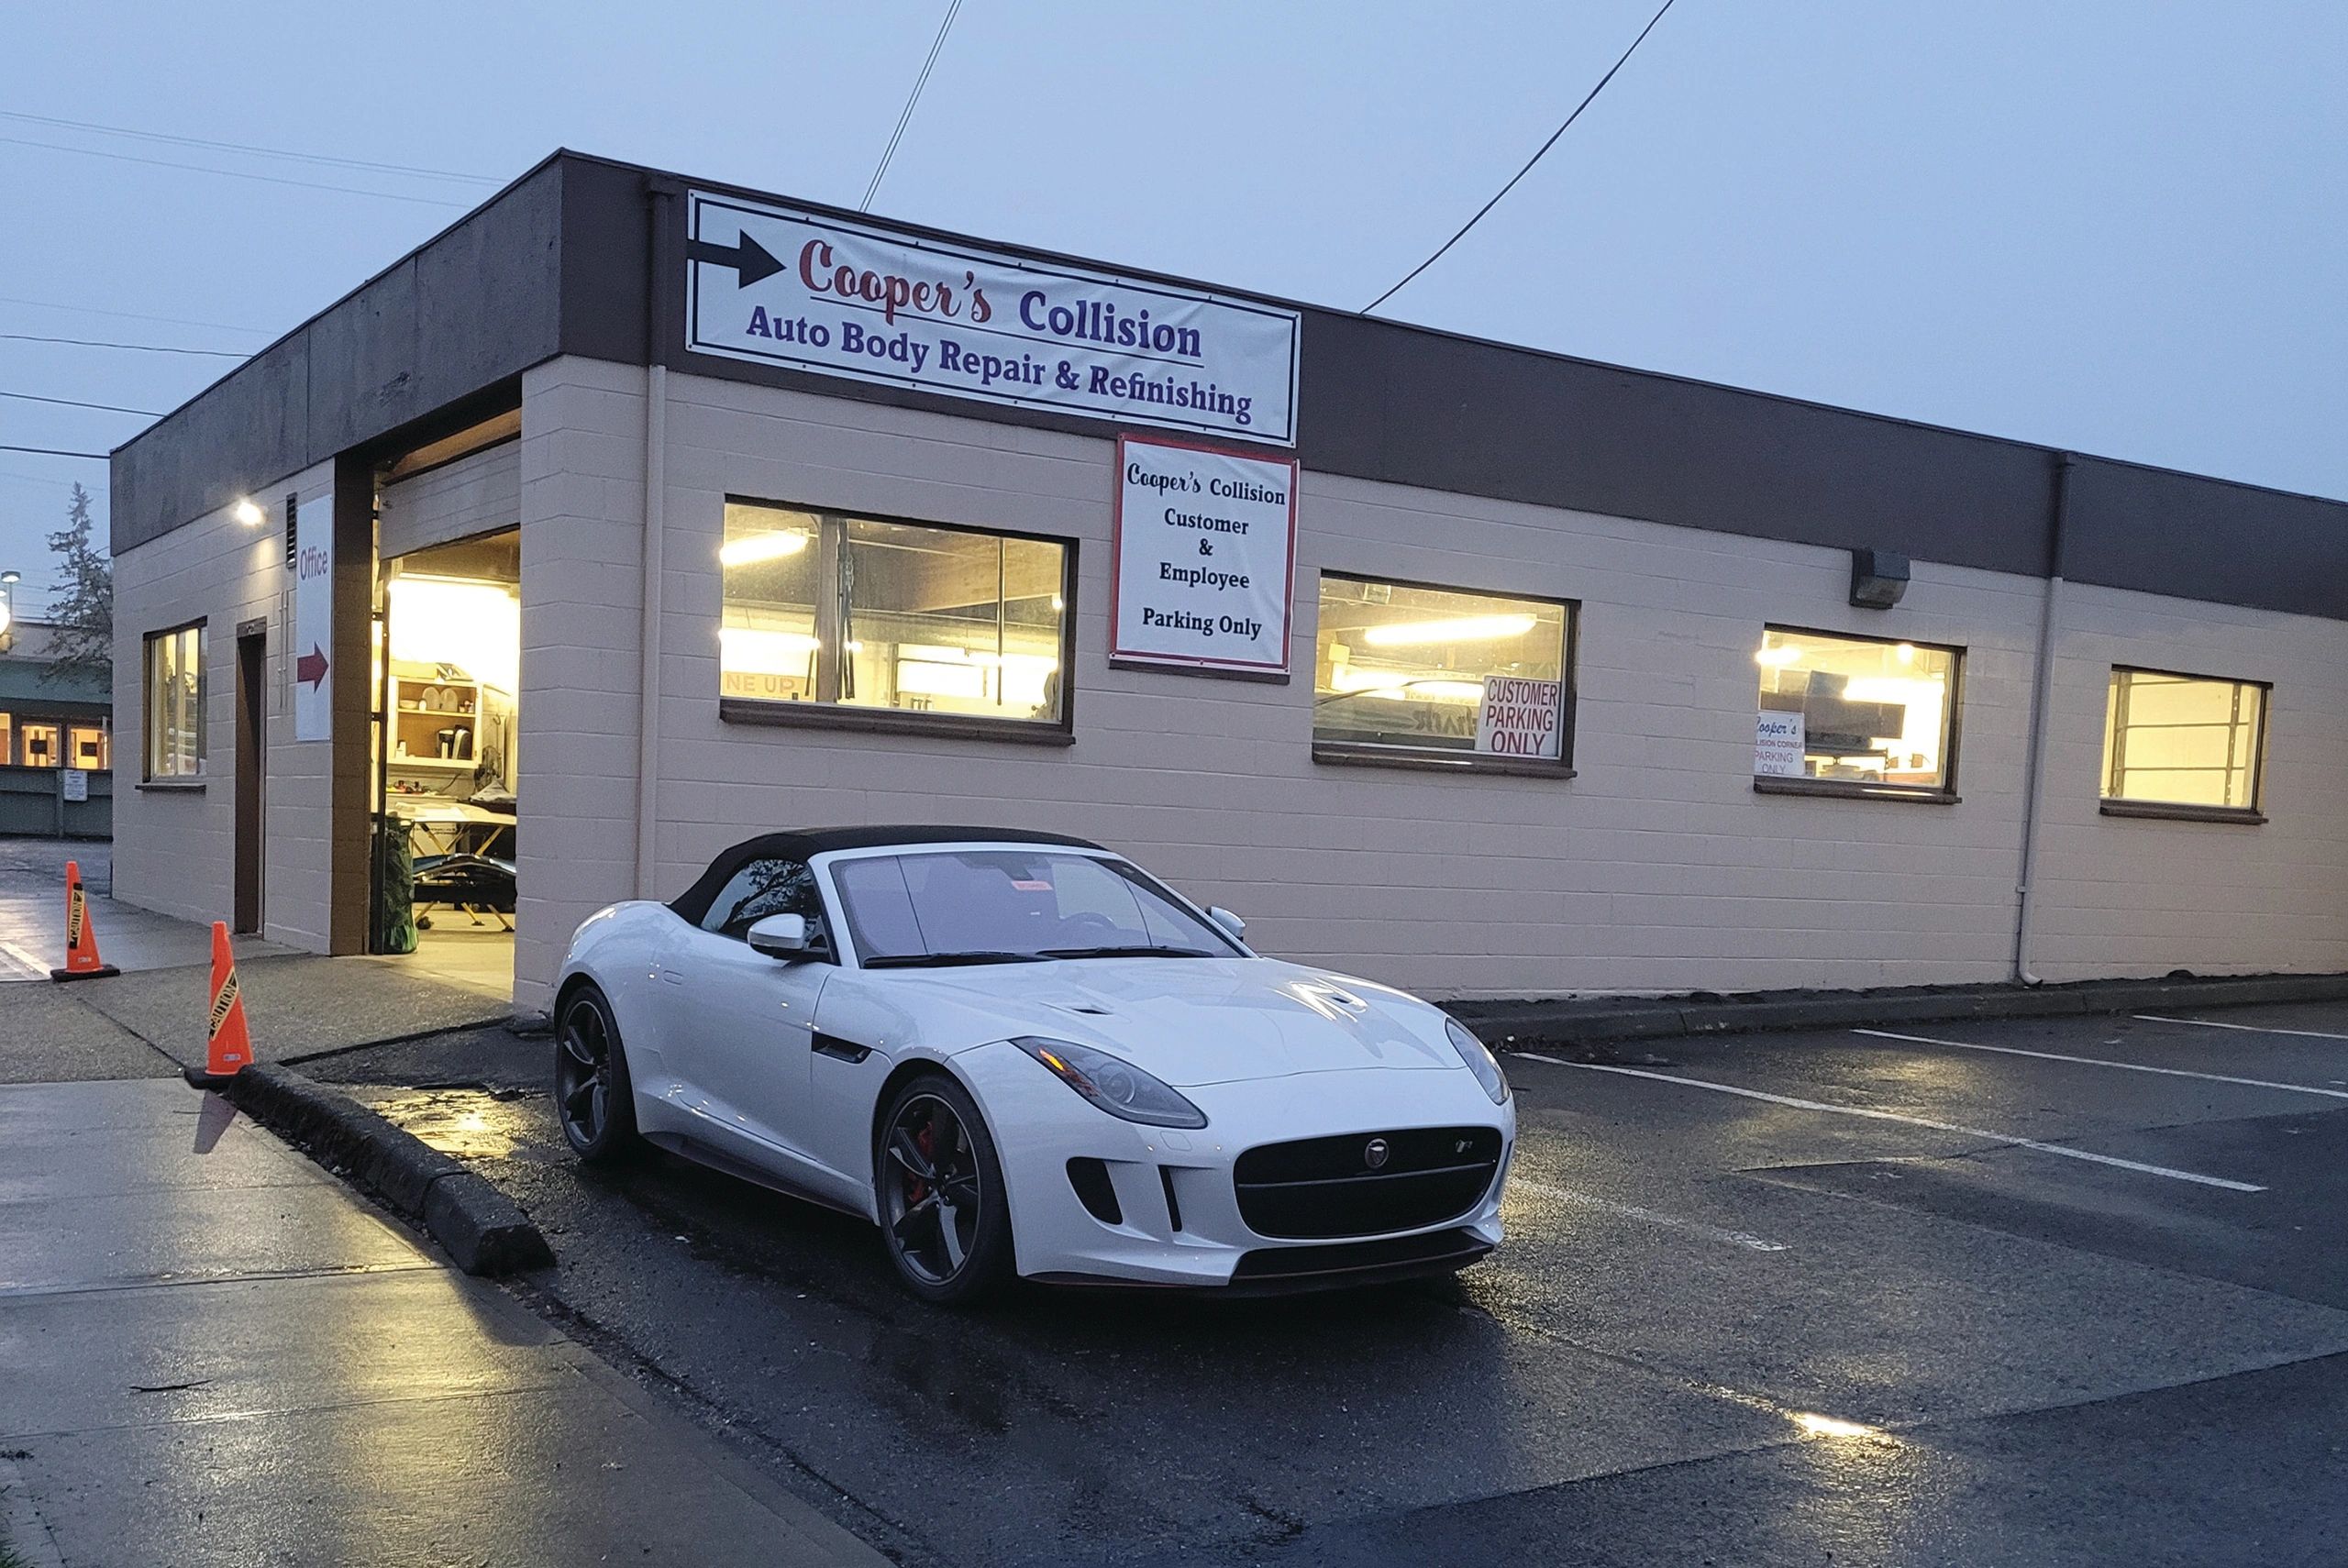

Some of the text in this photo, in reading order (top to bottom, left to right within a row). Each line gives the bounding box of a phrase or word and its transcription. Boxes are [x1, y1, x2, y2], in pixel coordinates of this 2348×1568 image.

[799, 238, 1202, 358] Cooper's Collision
[746, 305, 1252, 425] Auto Body Repair & Refinishing
[1127, 462, 1285, 505] Cooper's Collision
[1164, 508, 1249, 535] Customer
[1198, 538, 1213, 556] &
[301, 547, 327, 580] Office
[1159, 561, 1250, 591] Employee
[1143, 607, 1262, 641] Parking Only
[1487, 679, 1558, 707] CUSTOMER
[1485, 704, 1554, 732] PARKING
[1490, 730, 1546, 756] ONLY
[1762, 763, 1786, 774] ONLY
[210, 984, 238, 1029] CAUTION
